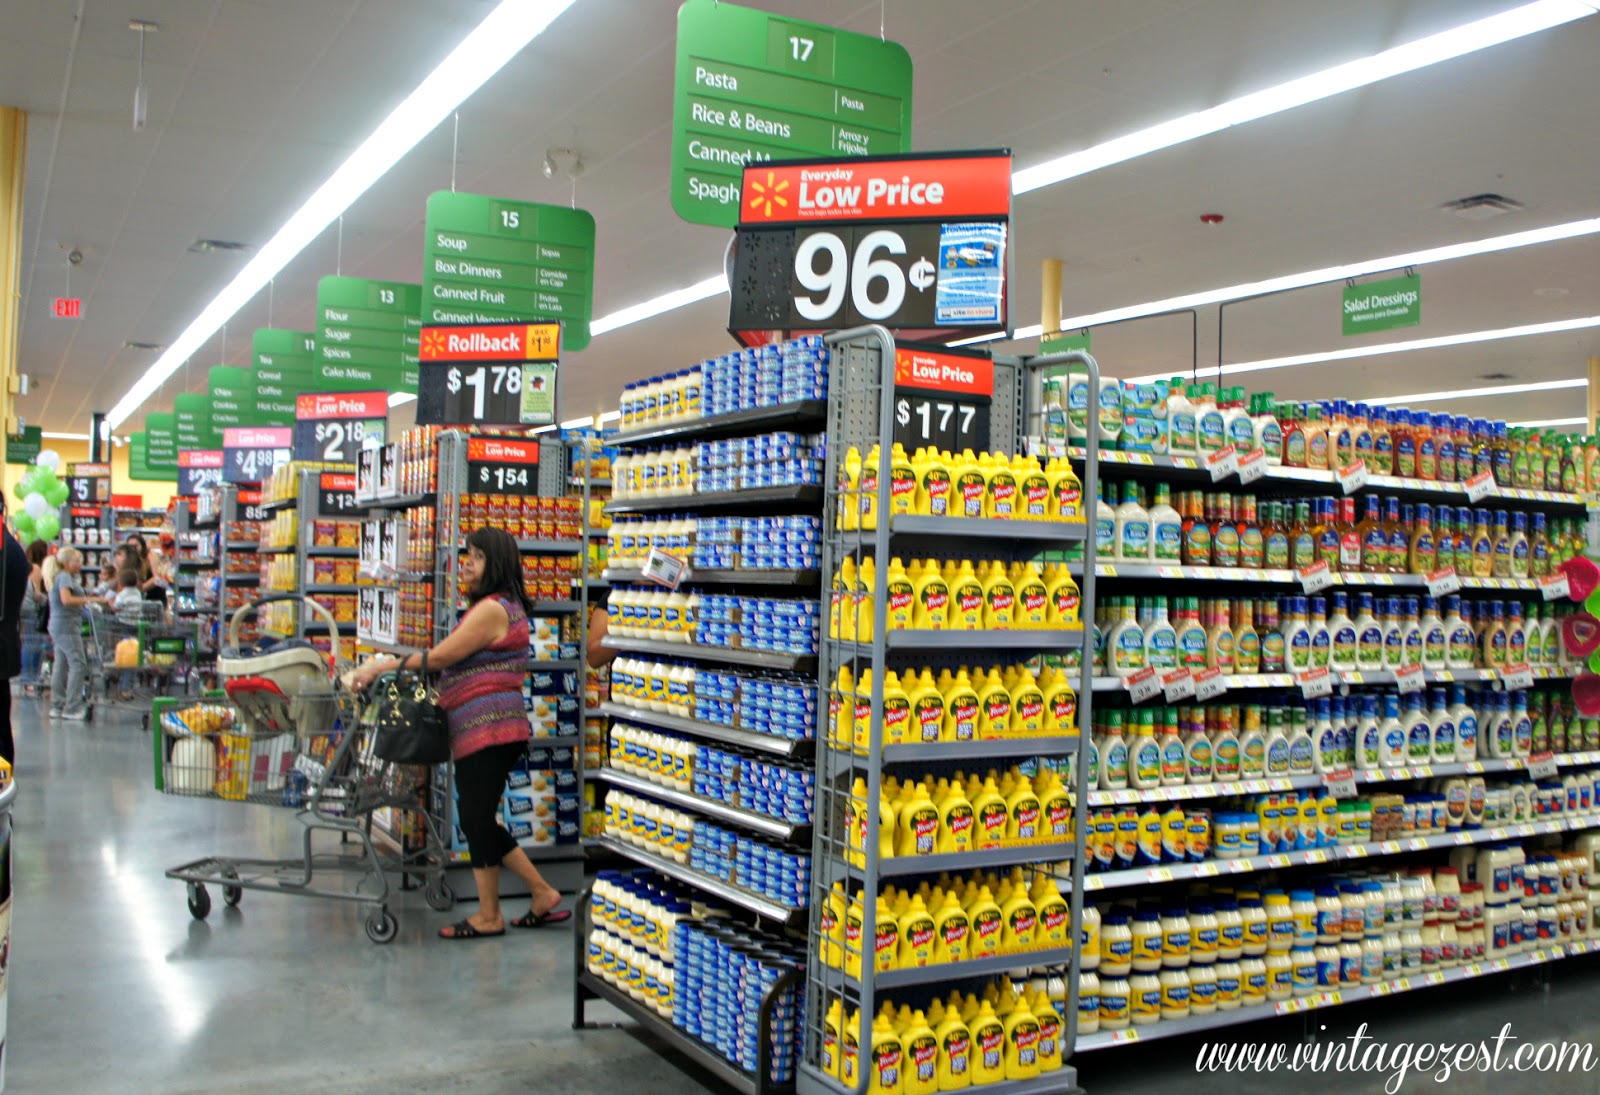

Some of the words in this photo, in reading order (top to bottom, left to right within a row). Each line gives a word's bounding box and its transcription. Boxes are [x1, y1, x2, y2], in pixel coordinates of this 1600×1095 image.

[789, 36, 814, 62] 17
[695, 66, 738, 92] Pasta
[841, 96, 864, 111] Pasta
[692, 103, 724, 125] Rice
[729, 110, 741, 129] &
[745, 113, 791, 138] Beans
[838, 128, 862, 143] Arroz
[689, 141, 752, 166] Canned
[838, 140, 868, 156] Frijoles
[801, 168, 853, 183] Everyday
[688, 177, 740, 204] Spagh
[799, 182, 862, 208] Low
[867, 176, 944, 206] Price
[501, 211, 519, 228] 15
[437, 234, 467, 251] Soup
[435, 260, 457, 275] Box
[459, 262, 502, 279] Dinners
[380, 289, 395, 304] 13
[433, 284, 478, 302] Canned
[479, 289, 506, 305] Fruit
[1344, 296, 1370, 314] Salad
[1371, 290, 1417, 308] Dressings
[56, 298, 80, 318] EXIT
[325, 309, 348, 321] Flour
[433, 309, 474, 323] Canned
[325, 327, 351, 342] Sugar
[304, 338, 315, 351] 11
[448, 332, 521, 353] Rollback
[260, 354, 273, 365] Tea
[322, 346, 351, 360] Spices
[258, 370, 282, 381] Cereal
[322, 366, 345, 378] Cake
[346, 368, 372, 380] Mixes
[913, 362, 940, 380] Low
[941, 365, 975, 384] Price
[214, 387, 232, 397] Chips
[257, 385, 282, 396] Coffee
[257, 402, 271, 411] Hot
[272, 403, 296, 412] Cereal
[316, 401, 338, 414] Low
[339, 399, 366, 414] Price
[256, 433, 276, 443] Price
[485, 445, 504, 455] Low
[504, 446, 526, 458] Price
